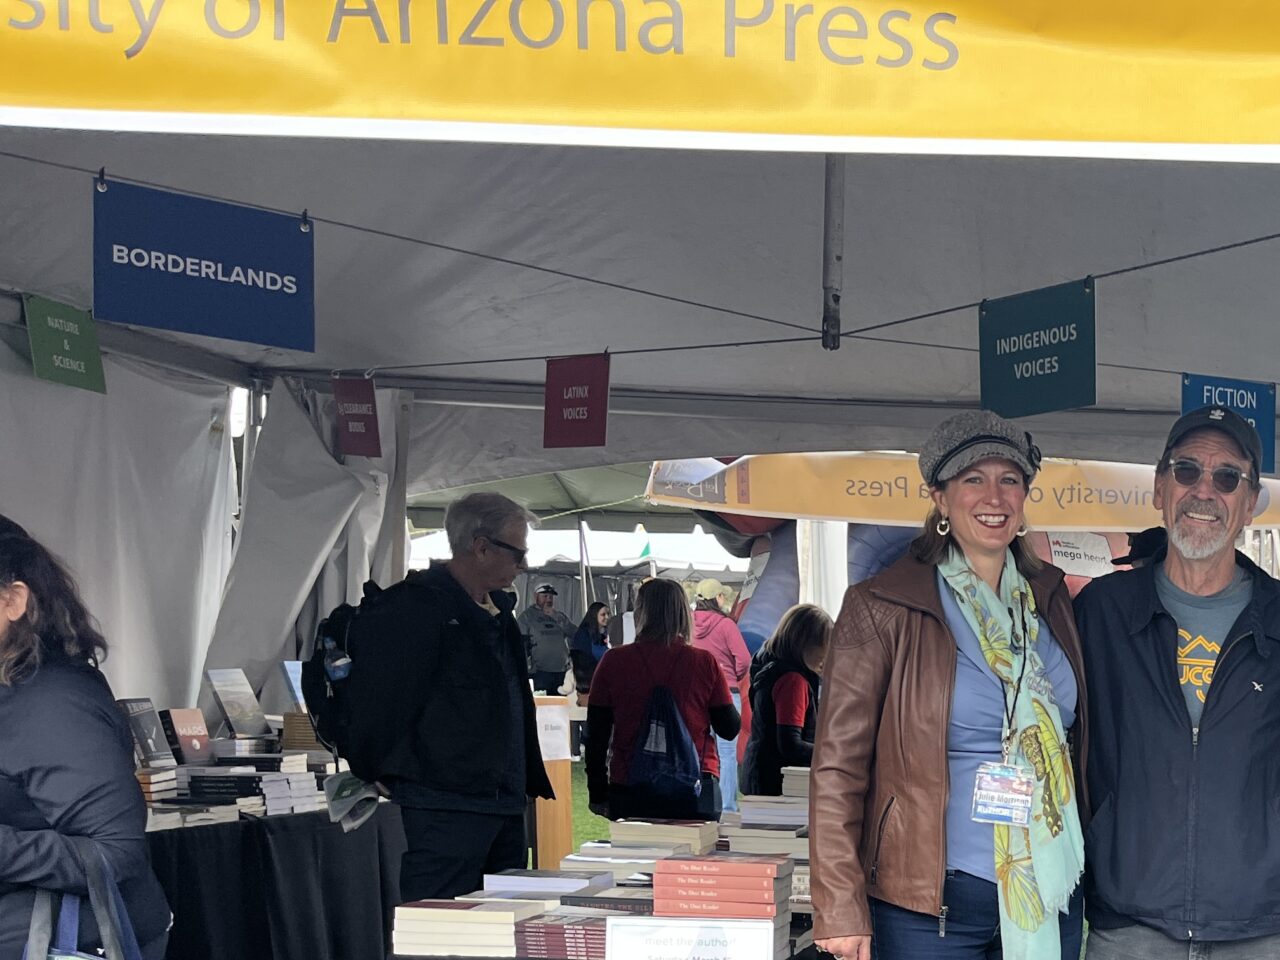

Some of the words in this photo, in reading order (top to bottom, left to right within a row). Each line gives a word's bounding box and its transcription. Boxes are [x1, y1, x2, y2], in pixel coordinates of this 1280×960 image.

[723, 0, 960, 71] Press
[112, 244, 298, 294] BORDERLANDS
[47, 316, 80, 335] NATURE
[64, 340, 70, 351] &
[996, 323, 1077, 355] INDIGENOUS
[53, 354, 86, 374] SCIENCE
[1014, 356, 1059, 379] VOICES
[563, 385, 589, 399] LATINX
[1203, 385, 1257, 409] FICTION
[563, 407, 588, 420] VOICES
[1054, 550, 1082, 561] mega
